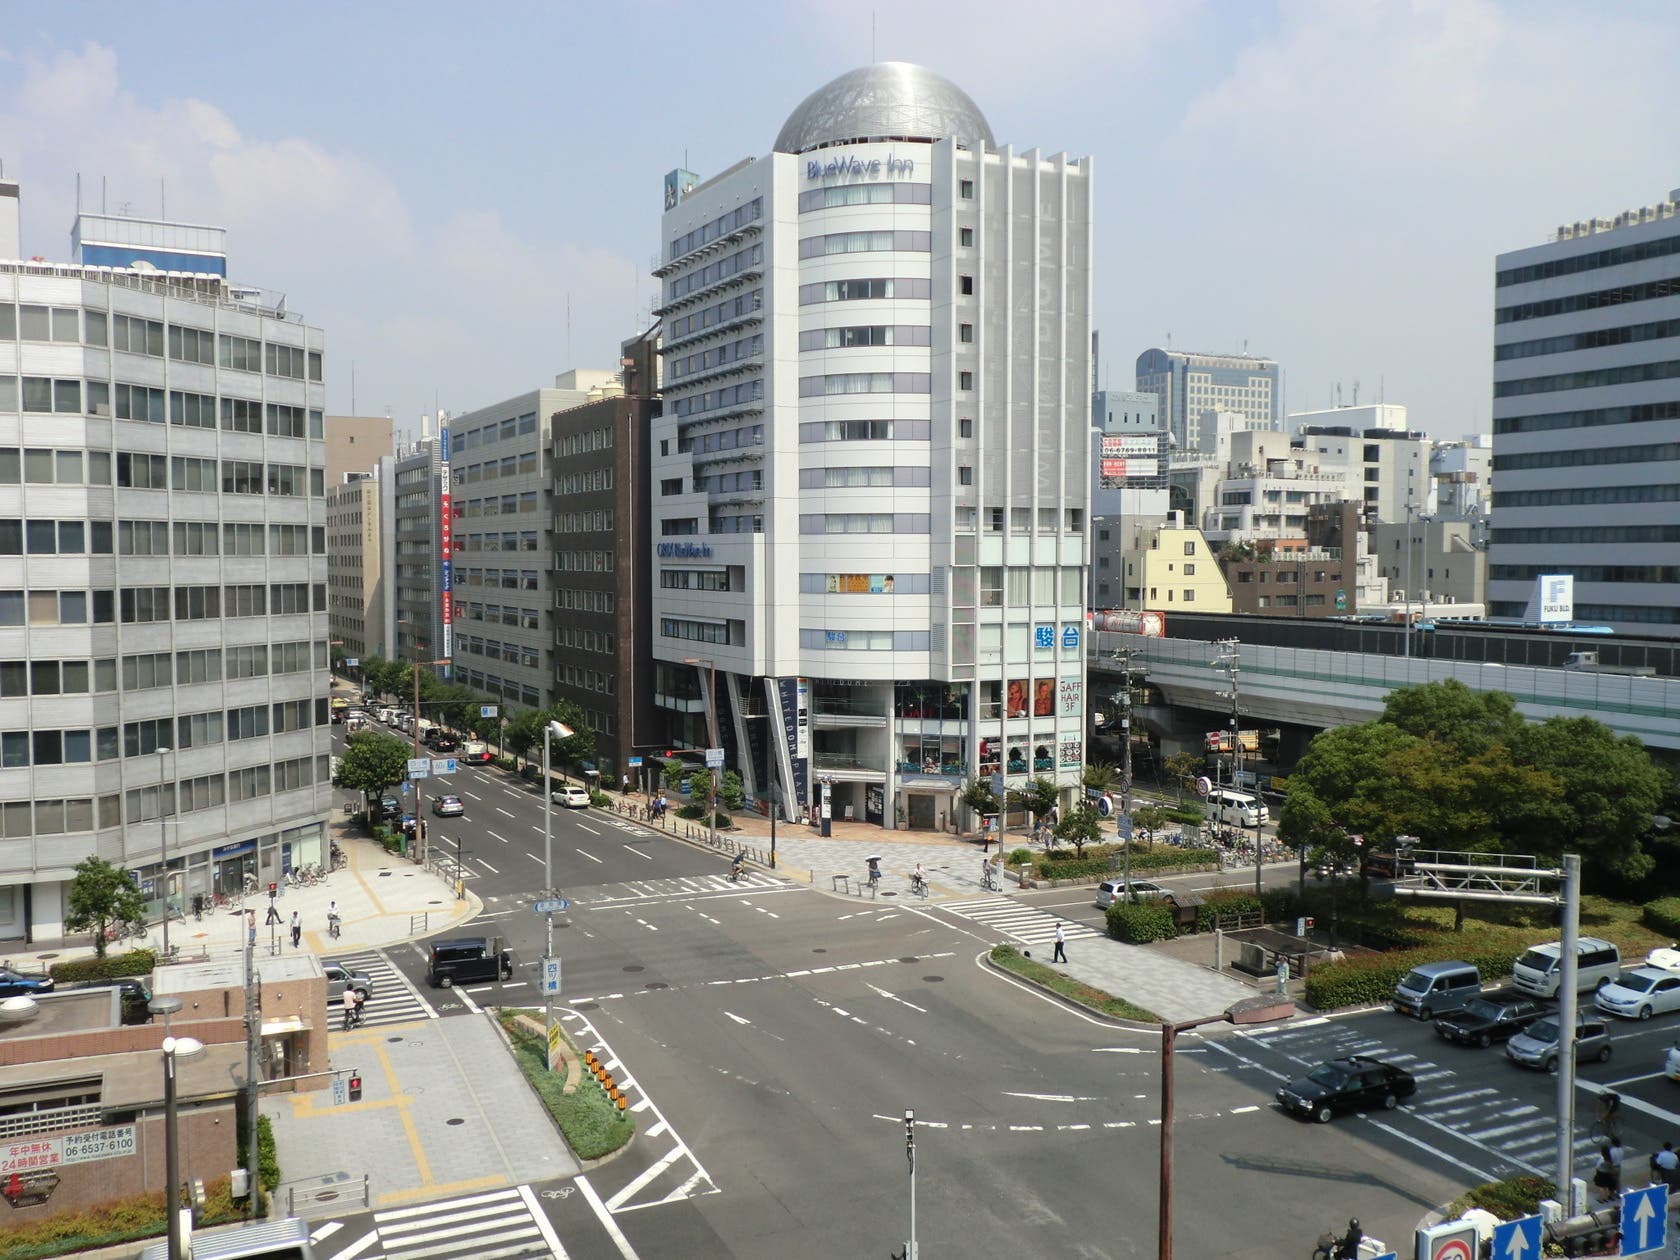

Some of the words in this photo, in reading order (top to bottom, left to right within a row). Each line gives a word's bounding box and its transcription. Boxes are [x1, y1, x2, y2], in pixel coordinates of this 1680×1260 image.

[807, 154, 881, 180] BlueWave
[887, 153, 914, 178] Inn
[1035, 626, 1080, 647] 駿台
[779, 681, 792, 721] WHITE
[1060, 693, 1080, 702] HAIR
[1065, 702, 1076, 712] 3F
[785, 725, 799, 760] DOME
[65, 1127, 132, 1146] 予約受付電話番号
[9, 1142, 52, 1157] 年中無休
[65, 1139, 133, 1157] 06-6537-6100
[1, 1153, 60, 1172] 24時間営業
